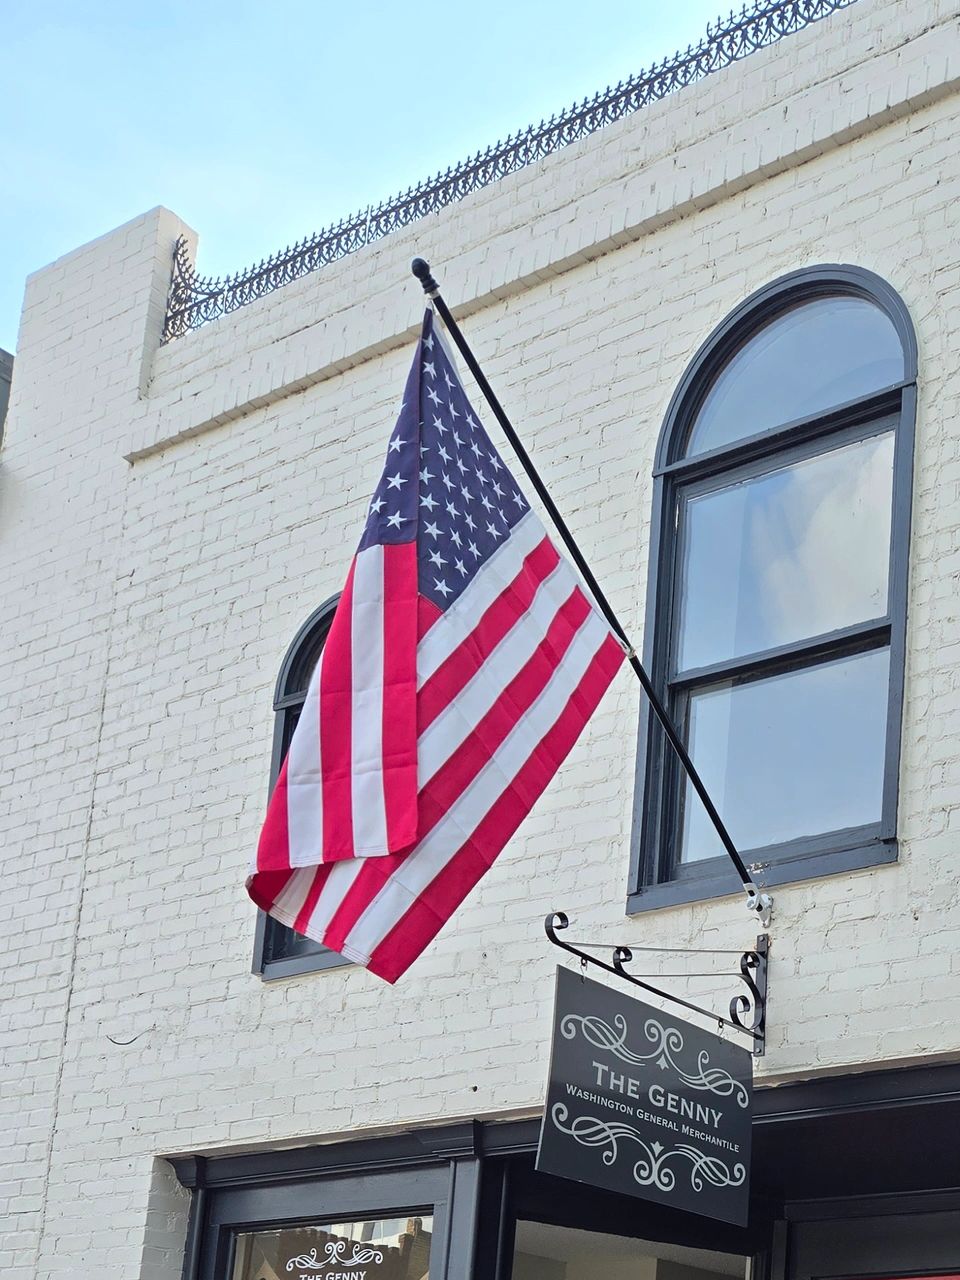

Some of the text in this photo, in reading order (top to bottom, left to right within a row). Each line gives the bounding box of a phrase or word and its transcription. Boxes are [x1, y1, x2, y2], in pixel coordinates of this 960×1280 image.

[566, 1083, 740, 1153] WASHINGTON GENERAL MERCHANTILE
[592, 1061, 723, 1129] THE GENNY
